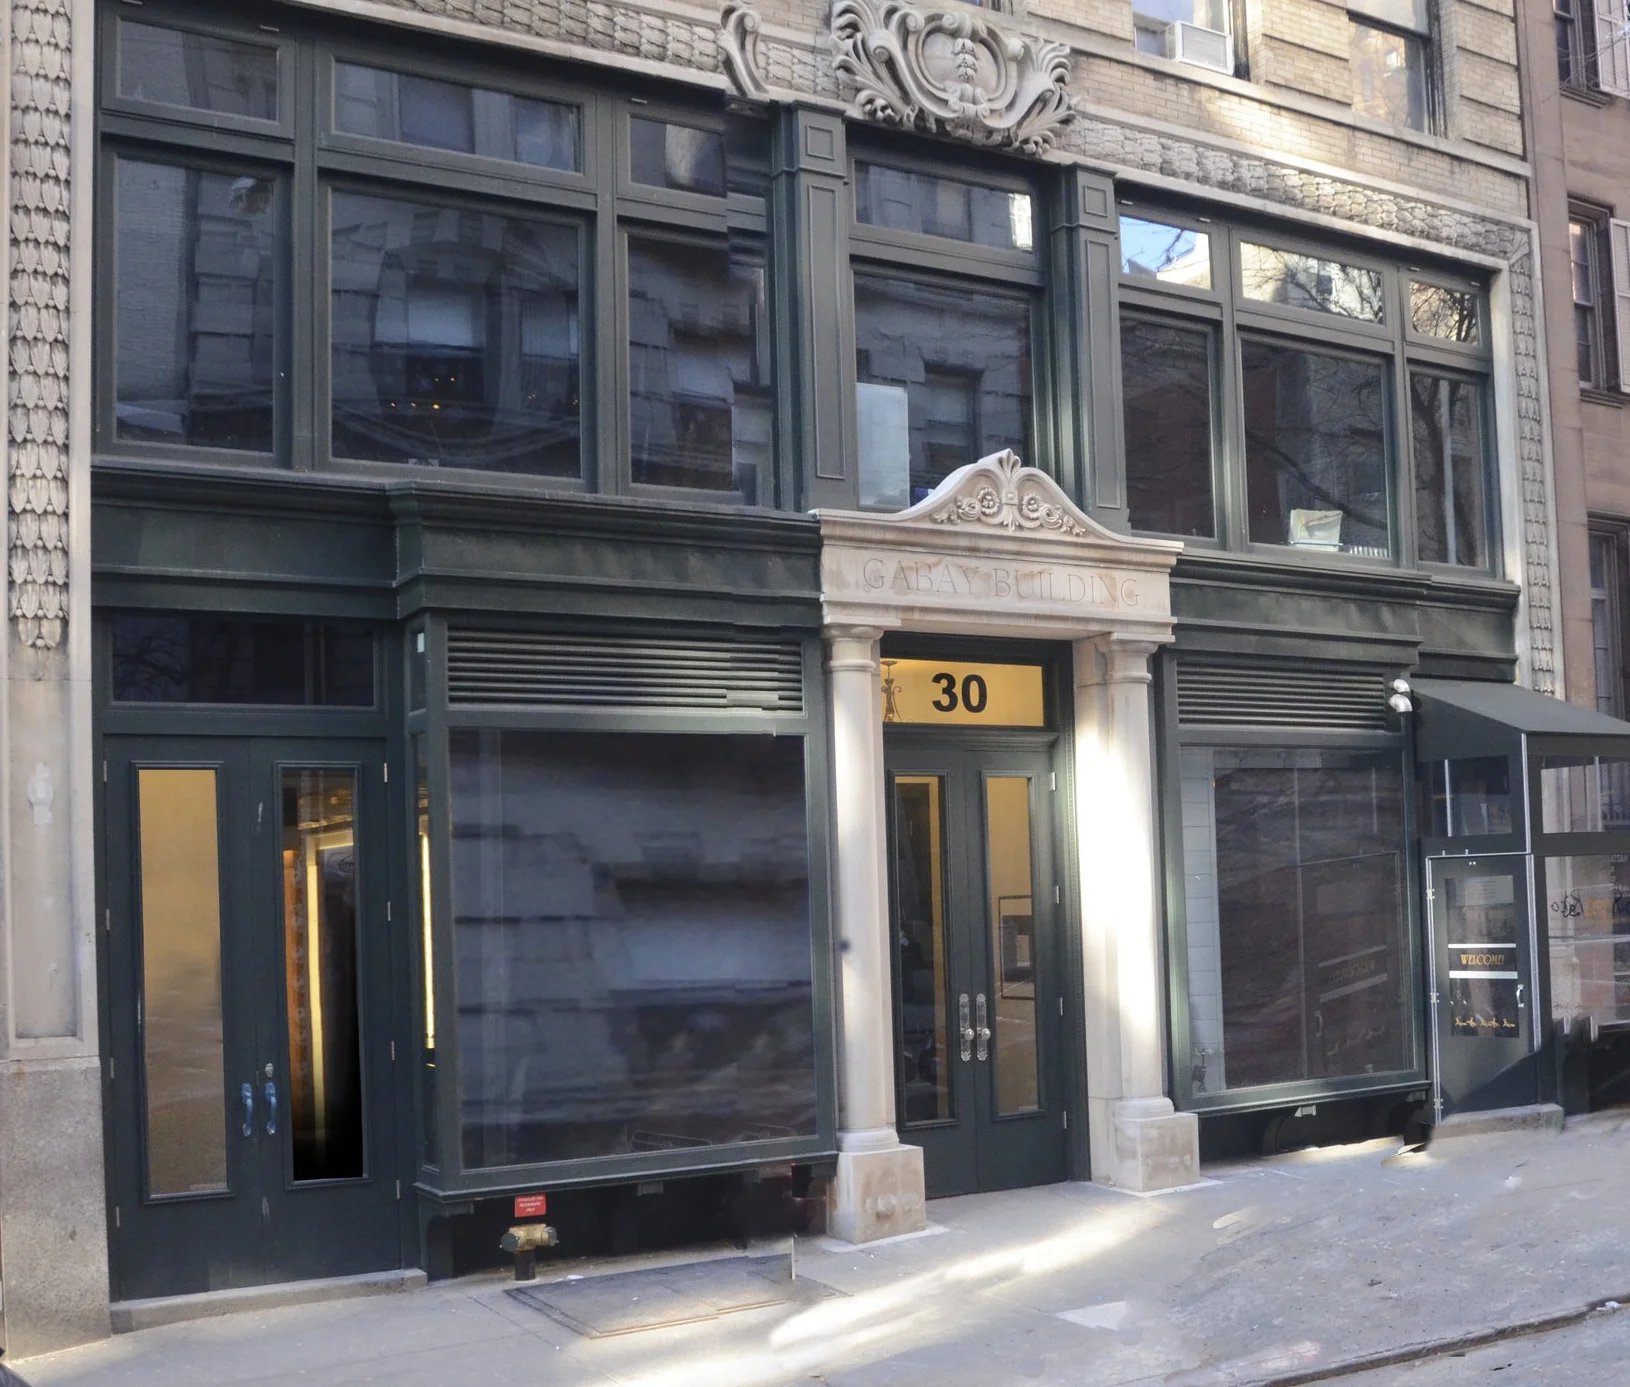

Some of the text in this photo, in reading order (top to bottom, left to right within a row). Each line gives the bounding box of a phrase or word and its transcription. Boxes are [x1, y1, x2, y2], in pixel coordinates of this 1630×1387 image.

[863, 558, 1141, 607] GABAY BUILDING
[931, 672, 988, 714] 30
